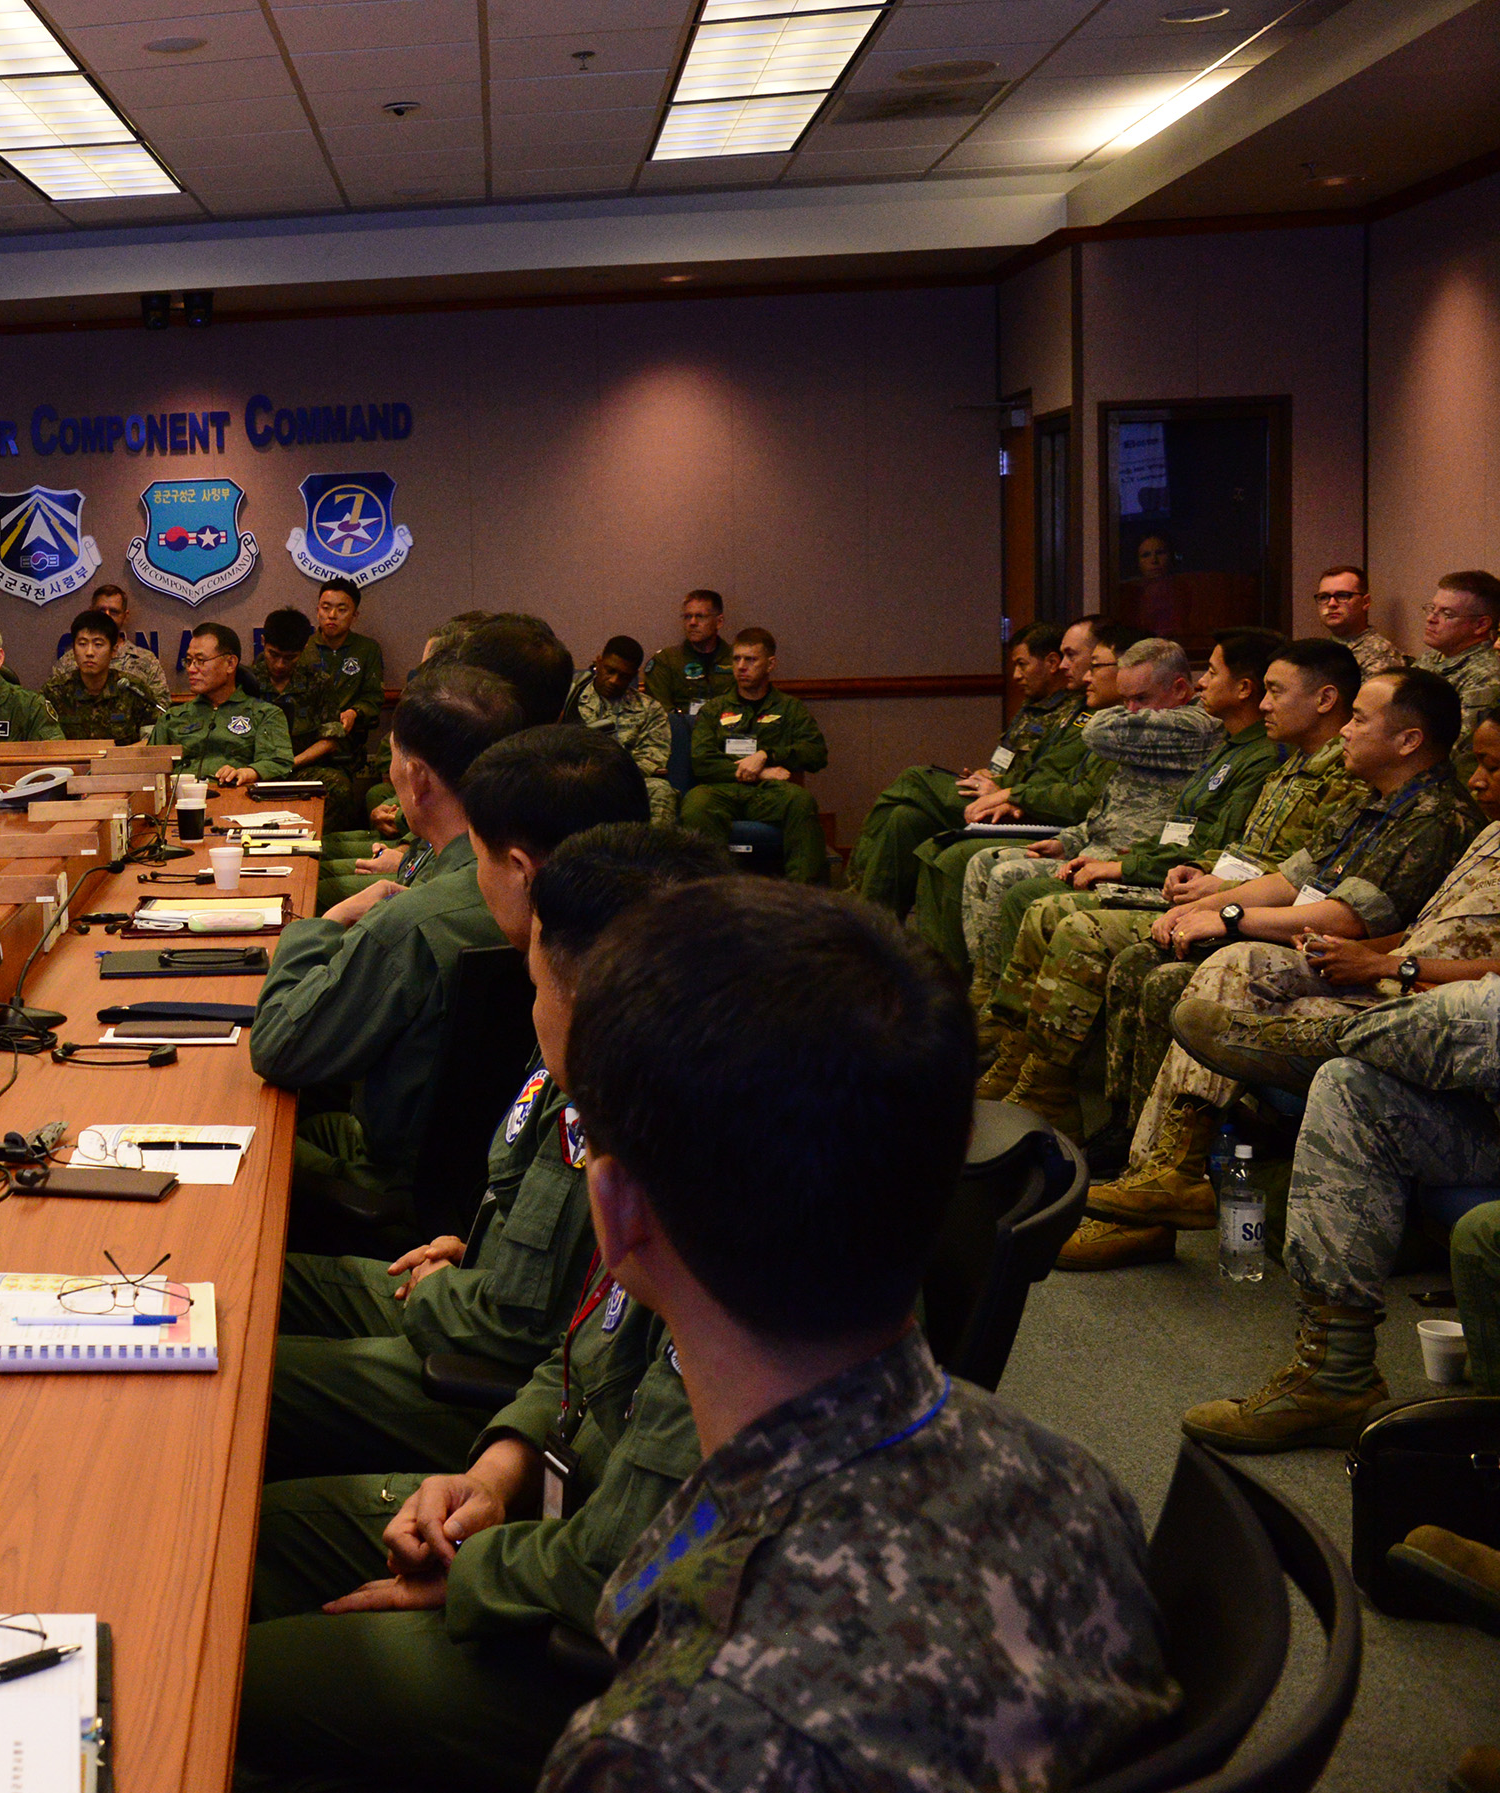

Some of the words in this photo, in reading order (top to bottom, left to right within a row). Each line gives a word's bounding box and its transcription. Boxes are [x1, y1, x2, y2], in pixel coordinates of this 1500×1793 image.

[134, 558, 150, 573] AIR
[148, 569, 207, 599] COMPONENT
[206, 554, 251, 589] COMMAND
[370, 548, 405, 577] FORCE
